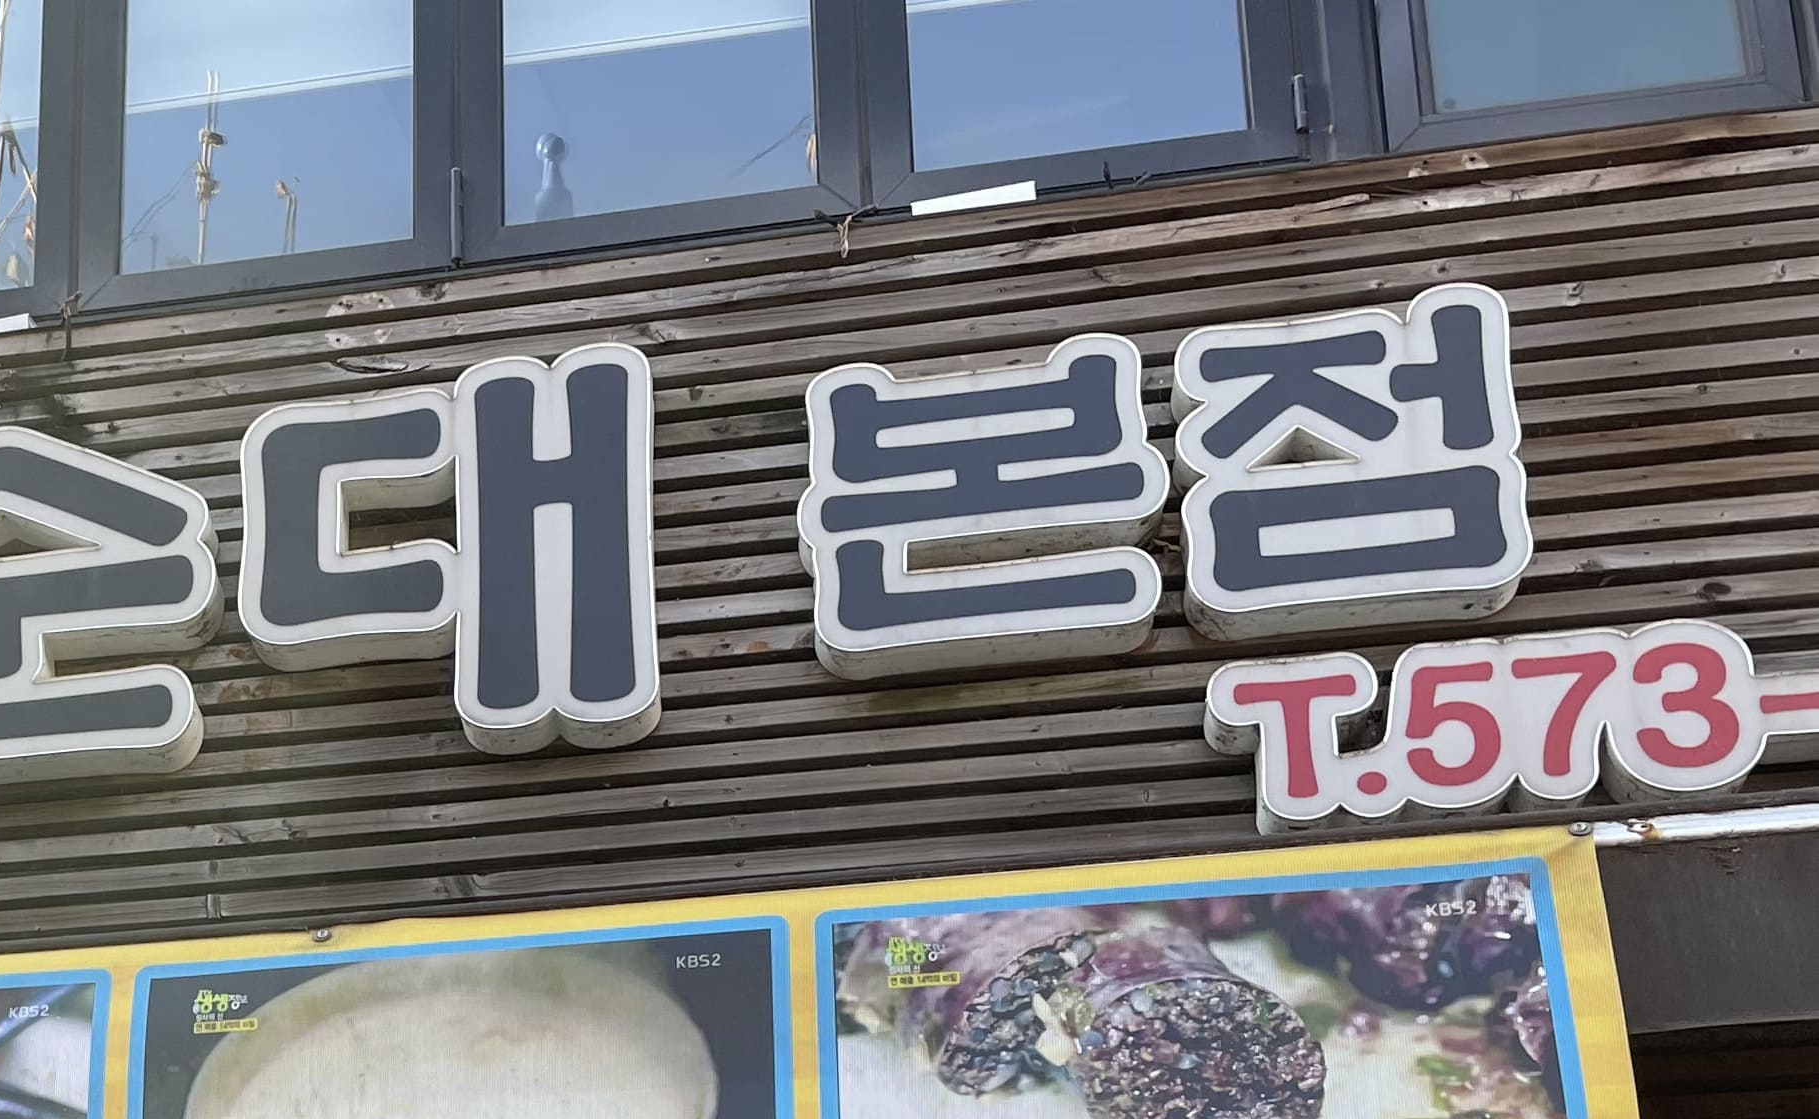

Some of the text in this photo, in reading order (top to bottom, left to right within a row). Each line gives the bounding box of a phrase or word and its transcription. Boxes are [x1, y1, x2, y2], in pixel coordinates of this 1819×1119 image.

[820, 304, 1507, 631] 본점
[1426, 900, 1478, 917] KBS2
[676, 953, 722, 969] KBS2
[8, 1004, 49, 1020] KBS2
